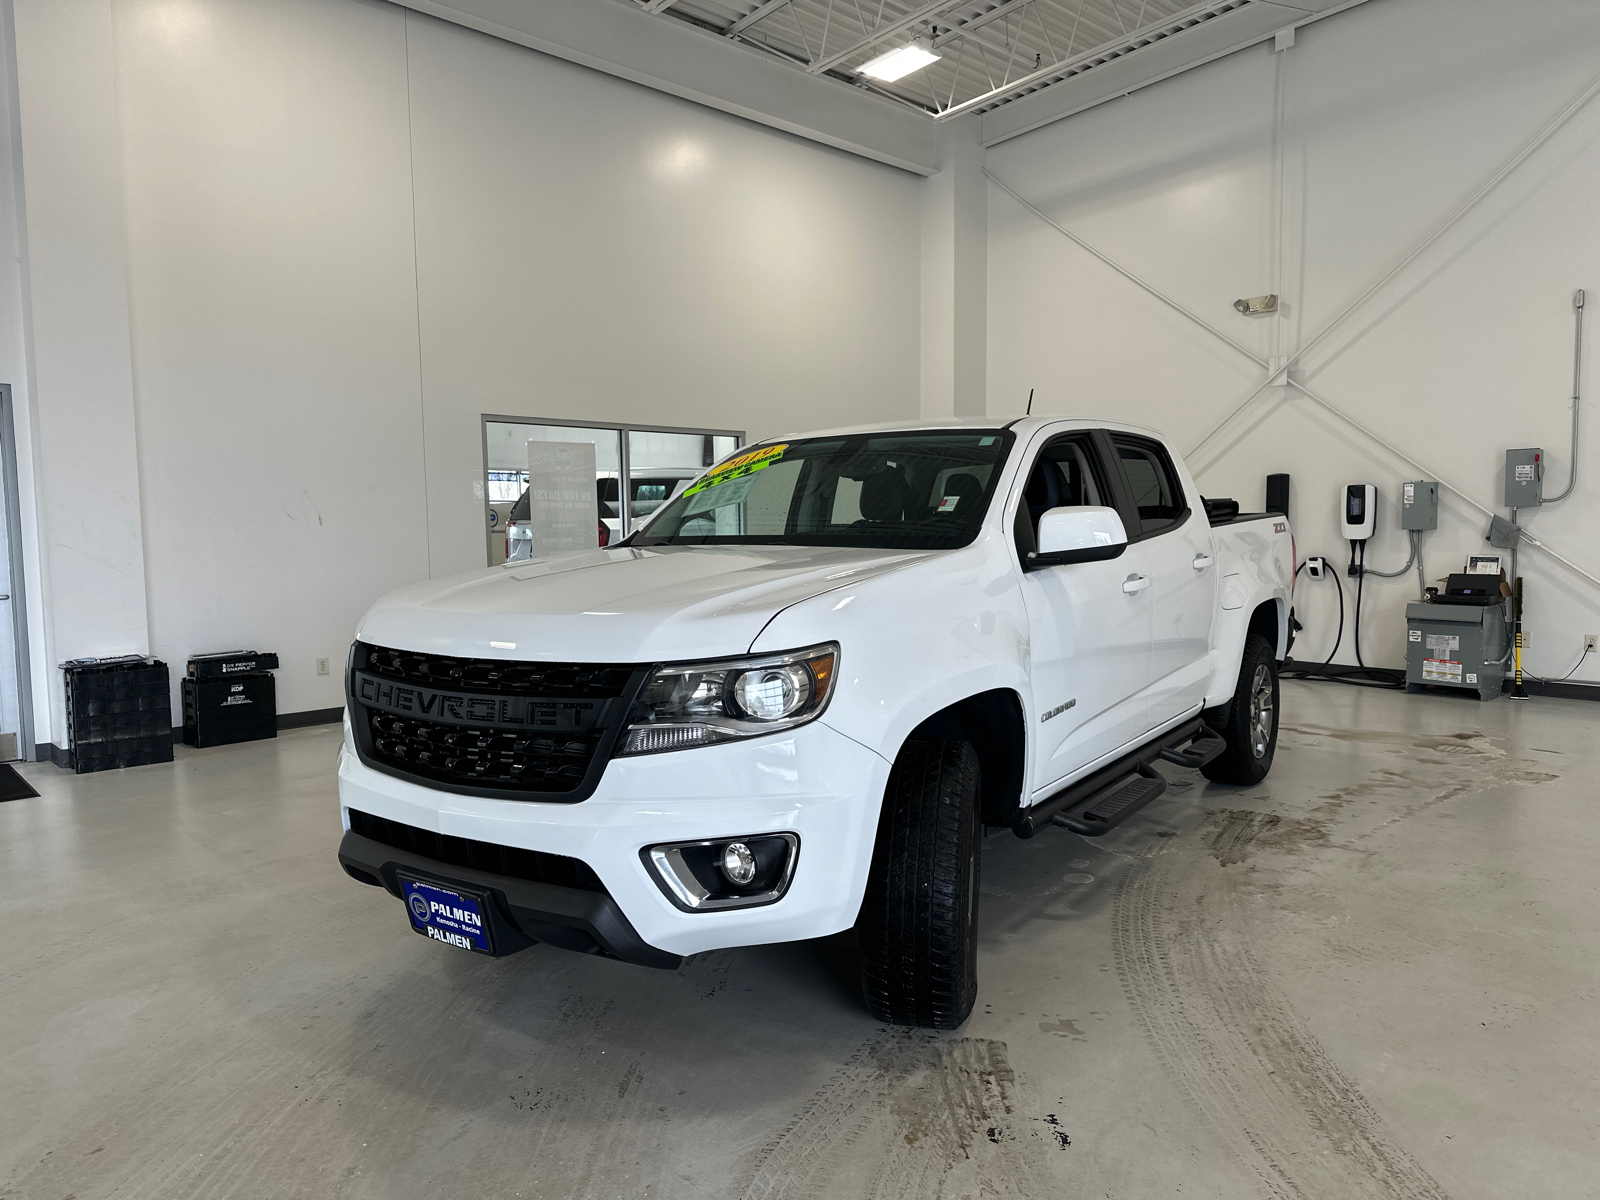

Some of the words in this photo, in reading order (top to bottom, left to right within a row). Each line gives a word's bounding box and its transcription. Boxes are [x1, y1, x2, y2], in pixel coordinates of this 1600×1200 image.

[720, 447, 775, 472] 2019
[744, 453, 782, 468] CAMERA
[360, 677, 594, 727] CHEVROLET
[430, 901, 482, 927] PALMEN
[436, 916, 459, 929] Kenosha
[461, 924, 481, 935] Racine
[427, 925, 471, 950] PALMEN
